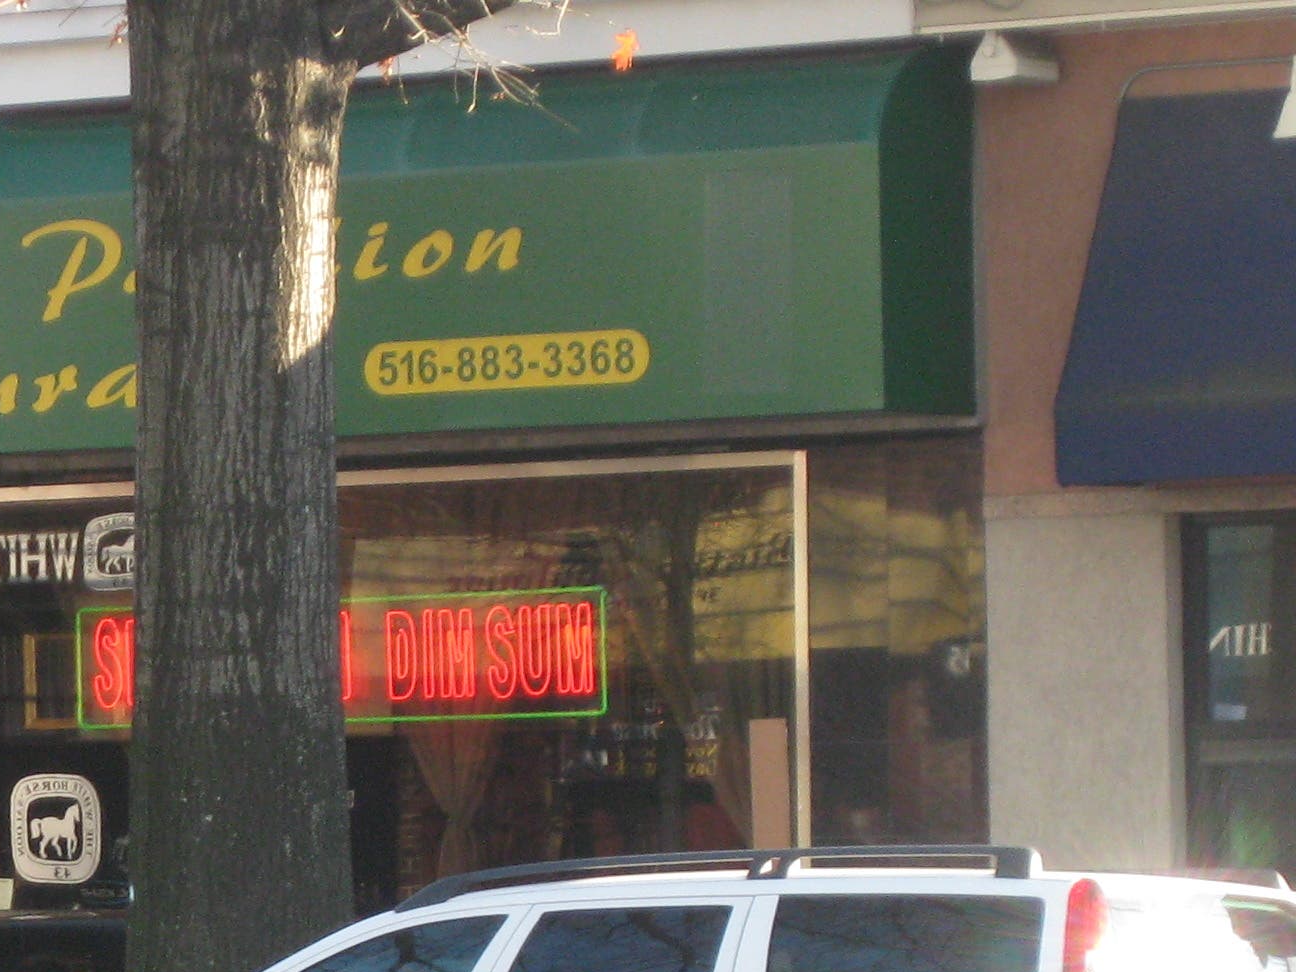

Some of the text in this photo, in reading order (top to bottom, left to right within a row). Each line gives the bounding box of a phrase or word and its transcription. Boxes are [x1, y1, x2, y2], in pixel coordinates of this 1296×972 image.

[21, 217, 523, 323] Pion
[377, 336, 637, 387] 516-883-3368
[384, 607, 475, 701] DIM
[485, 601, 593, 700] SUM
